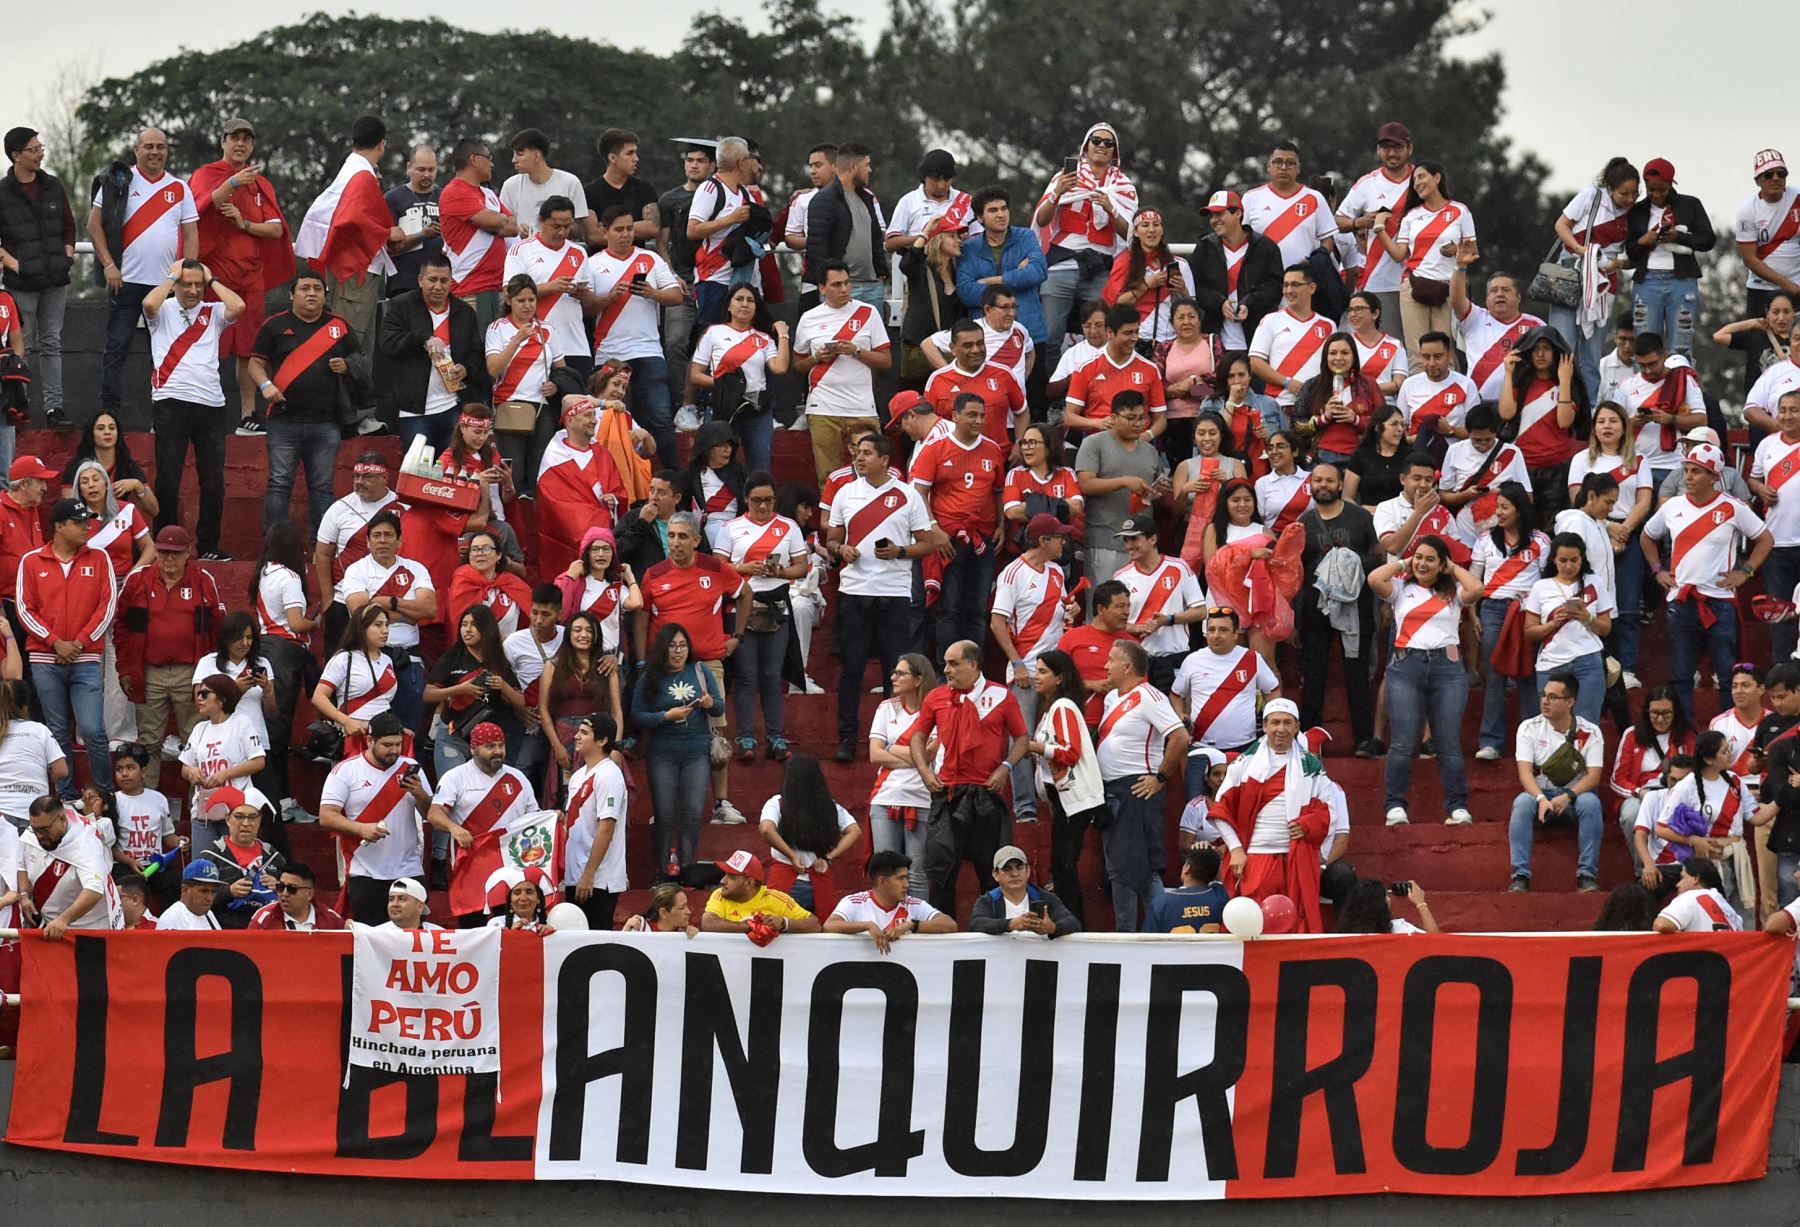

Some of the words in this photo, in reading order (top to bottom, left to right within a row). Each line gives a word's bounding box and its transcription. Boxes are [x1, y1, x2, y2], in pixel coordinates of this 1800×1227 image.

[1756, 150, 1781, 166] ERU
[1782, 460, 1792, 476] 9
[964, 472, 974, 489] 9
[206, 742, 222, 759] TE
[200, 758, 229, 778] AMO
[131, 815, 150, 831] TE
[127, 831, 157, 849] AMO
[1182, 906, 1210, 918] JESUS
[403, 927, 458, 955] TE
[385, 959, 479, 995] AMO
[368, 999, 482, 1041] PERÚ
[64, 935, 263, 1151] LA
[352, 1036, 426, 1058] Hinchada
[432, 1045, 497, 1060] peruana
[373, 1060, 392, 1072] en
[397, 1062, 475, 1075] Argentina
